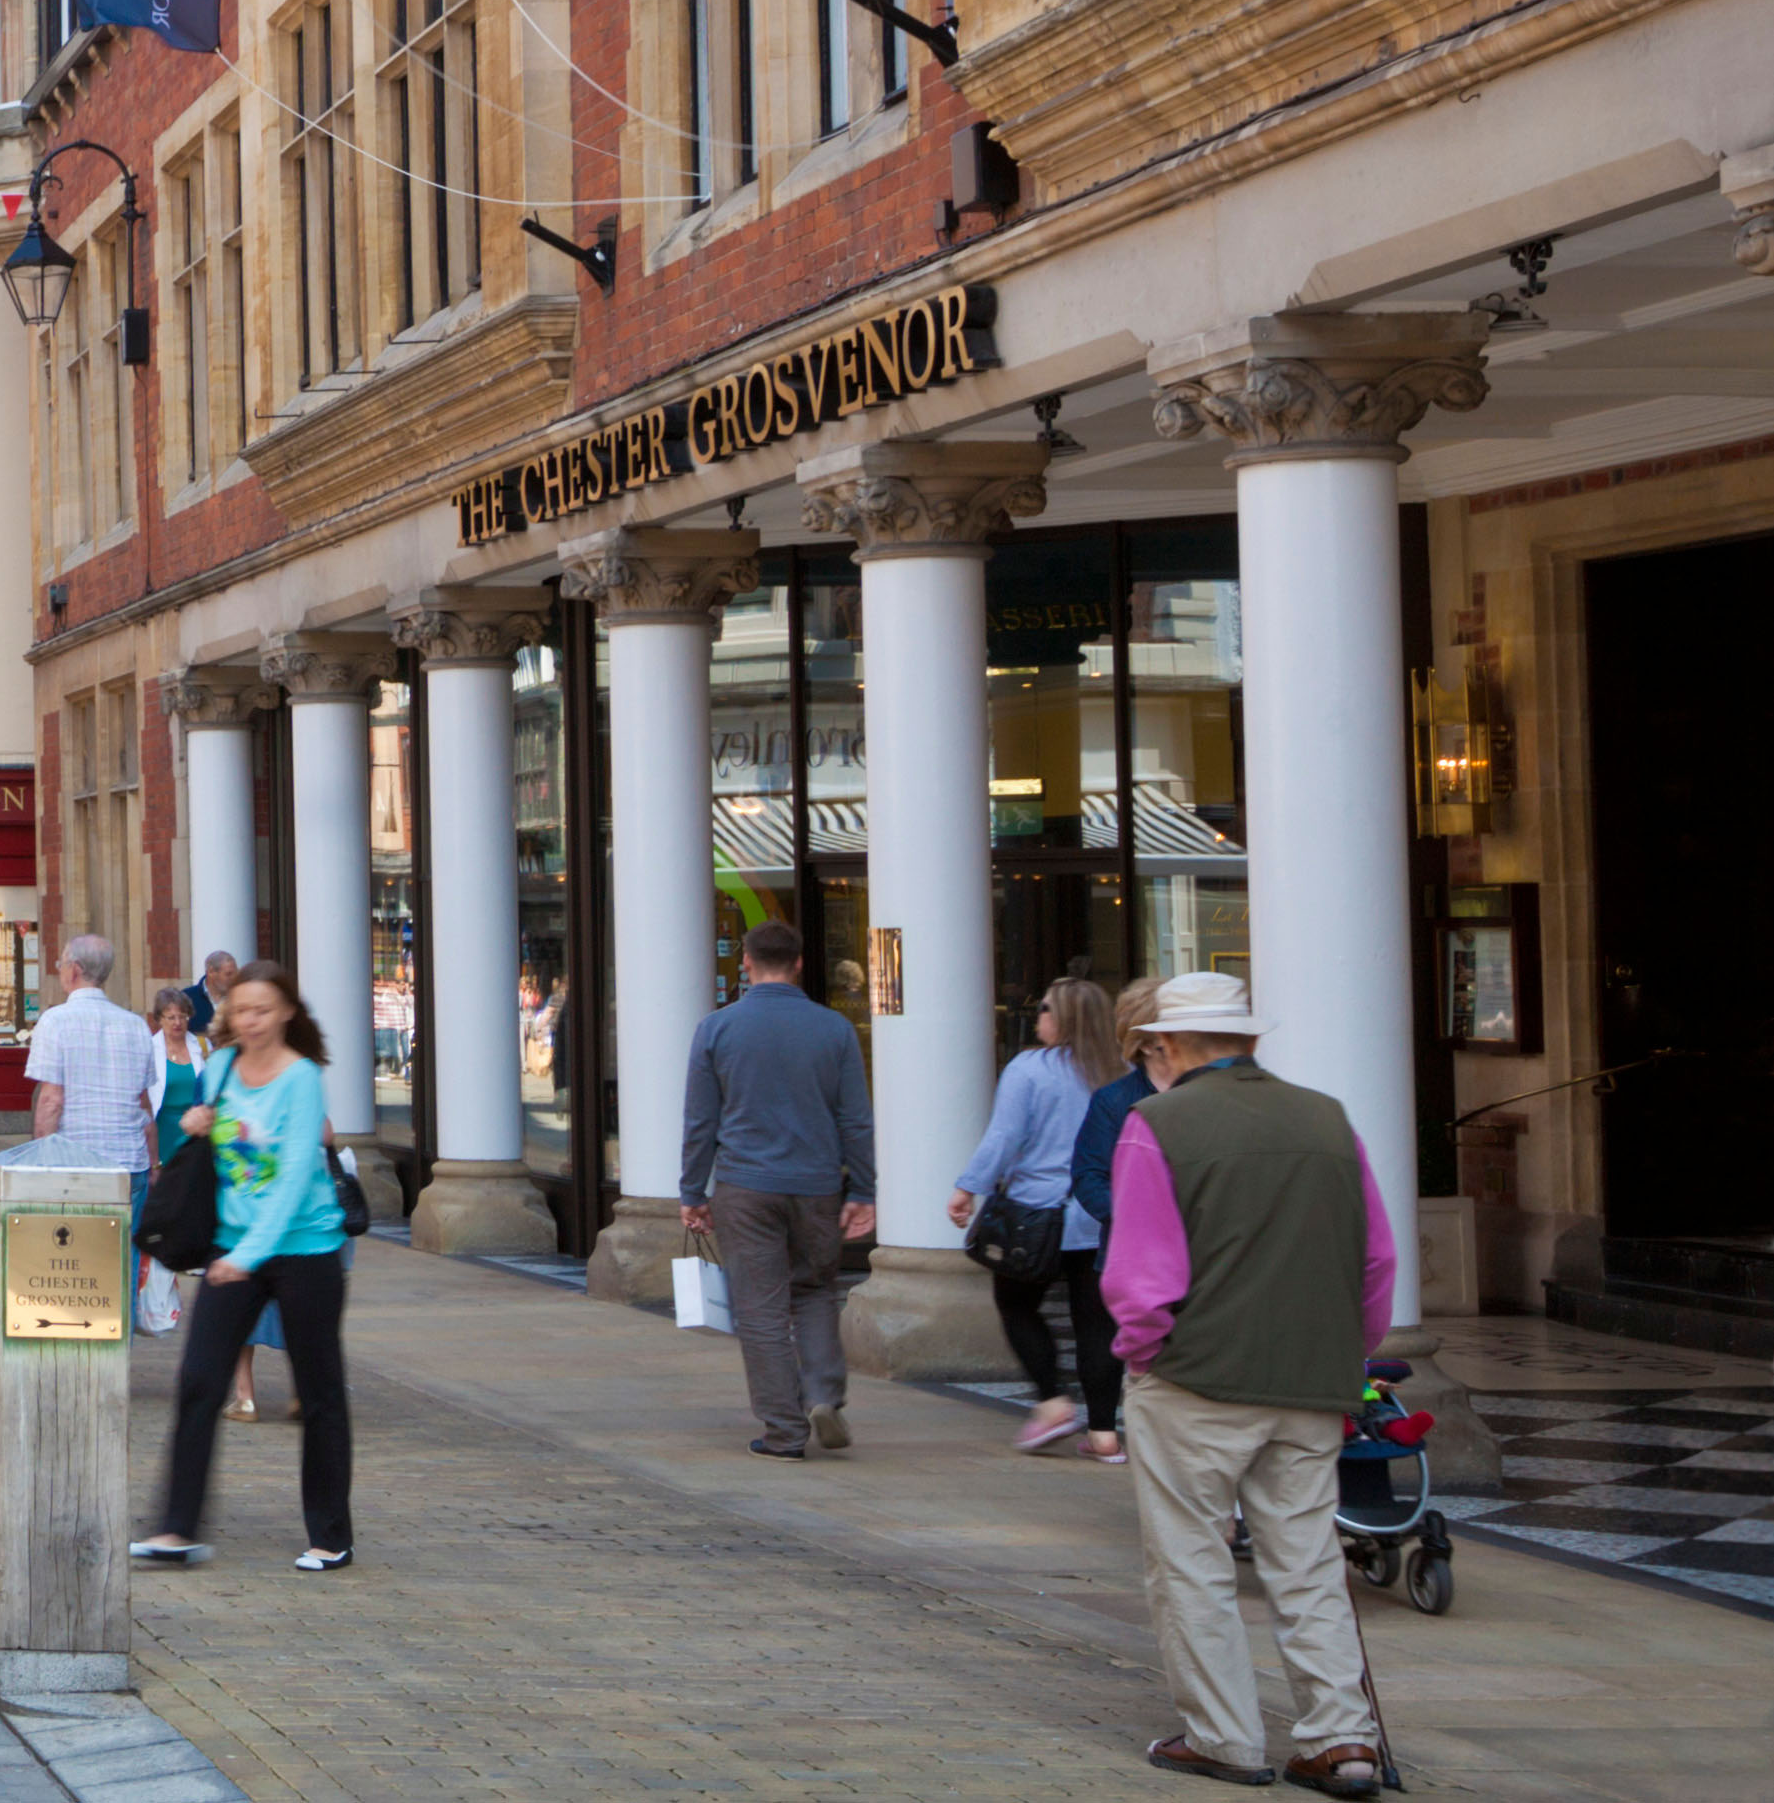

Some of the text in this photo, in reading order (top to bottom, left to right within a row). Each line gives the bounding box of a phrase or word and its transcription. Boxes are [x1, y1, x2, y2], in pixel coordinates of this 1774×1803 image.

[451, 284, 975, 548] THE CHESTER GROSVENOR
[49, 1258, 81, 1272] THE
[28, 1275, 99, 1290] CHESTER
[15, 1294, 112, 1309] GROSVENOR
